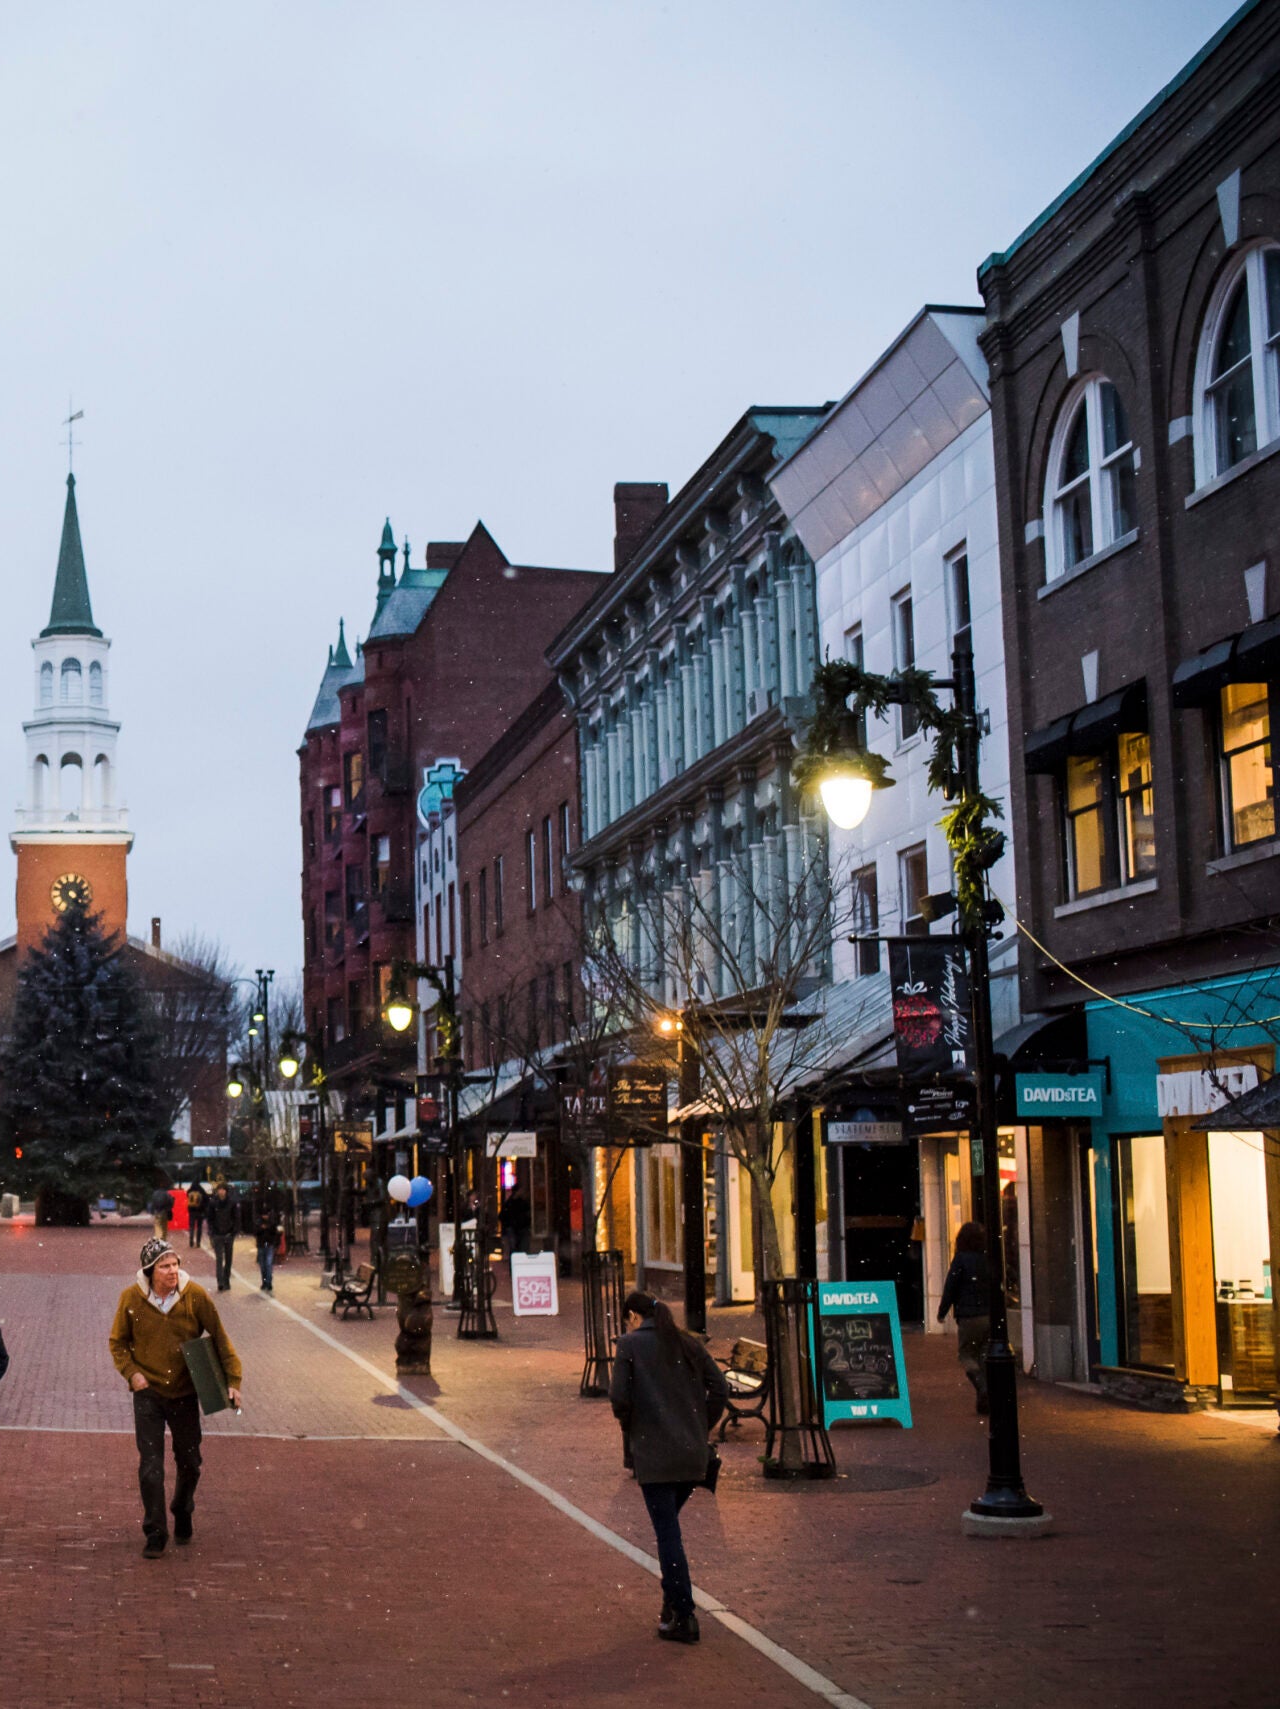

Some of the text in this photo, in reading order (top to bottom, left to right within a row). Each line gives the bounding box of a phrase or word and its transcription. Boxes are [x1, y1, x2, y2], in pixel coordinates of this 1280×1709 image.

[940, 954, 968, 1048] Happy Holidays
[519, 1280, 550, 1294] 50%
[520, 1293, 550, 1306] OFF
[823, 1339, 850, 1371] 2
